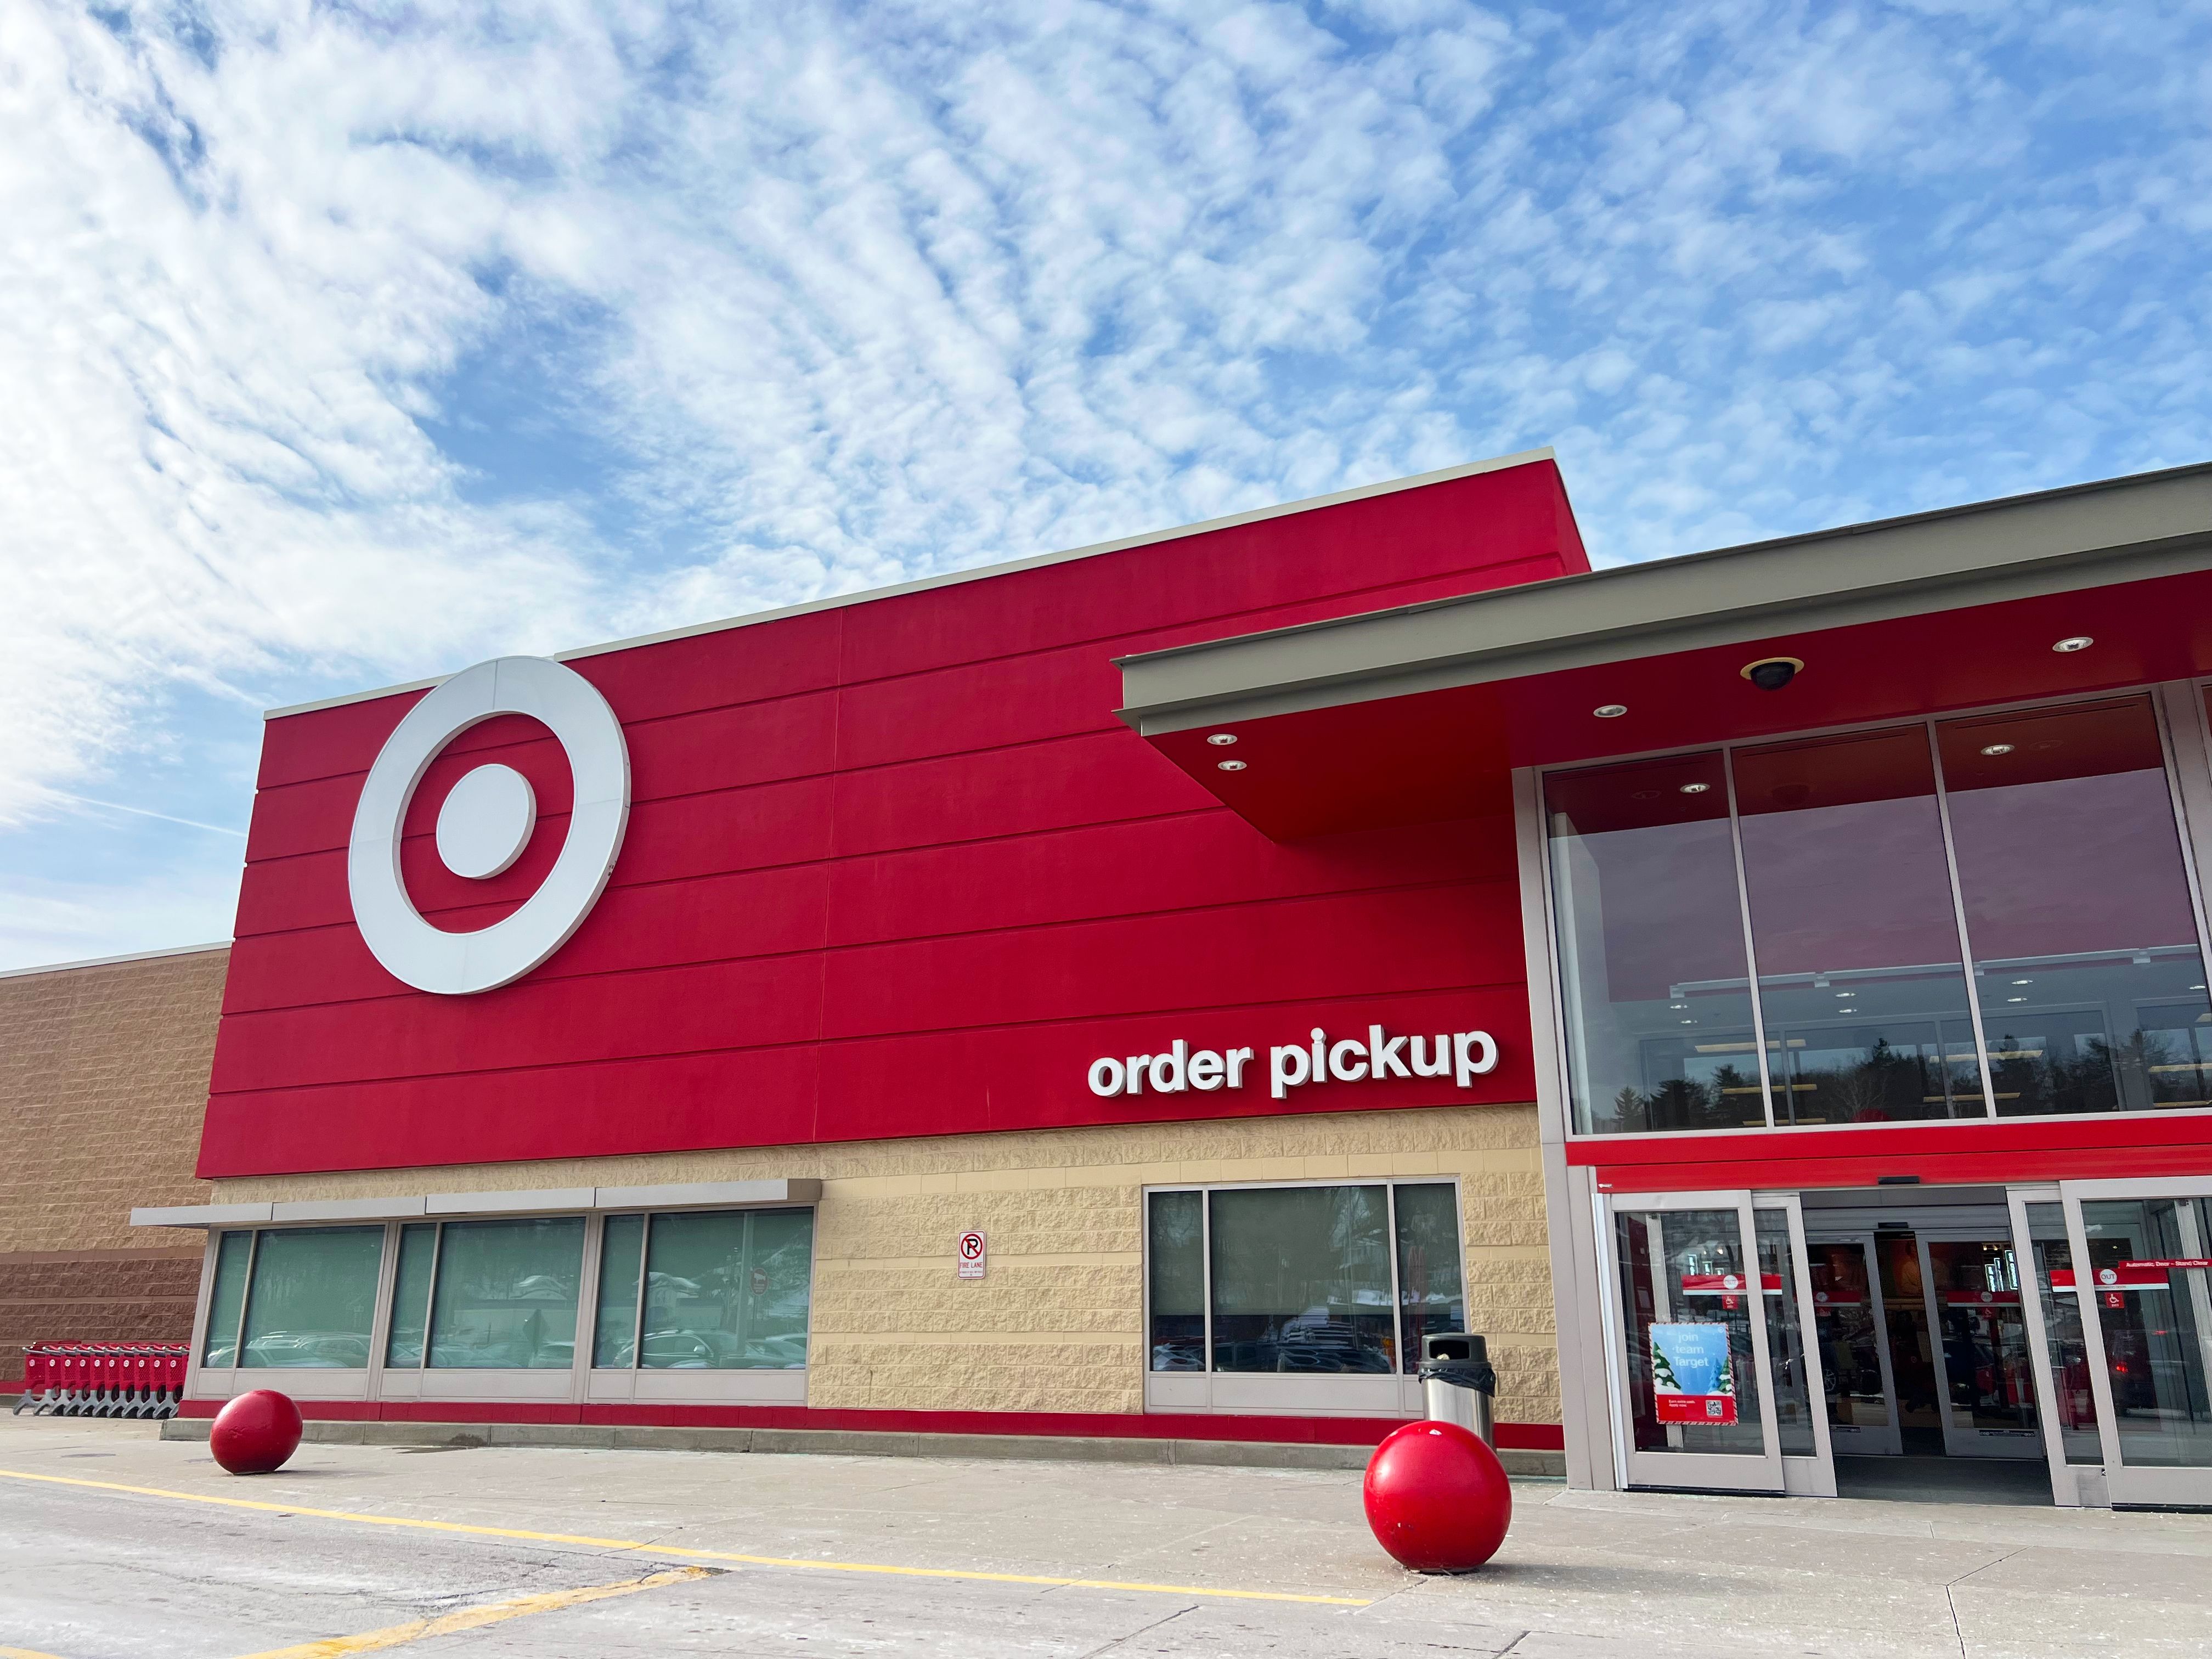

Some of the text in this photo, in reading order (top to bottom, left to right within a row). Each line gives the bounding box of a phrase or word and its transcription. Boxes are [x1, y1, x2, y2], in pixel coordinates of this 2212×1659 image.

[1087, 1024, 1499, 1099] order pickup
[1678, 1332, 1699, 1344] join
[1675, 1345, 1704, 1354] team
[1673, 1356, 1709, 1369] Target
